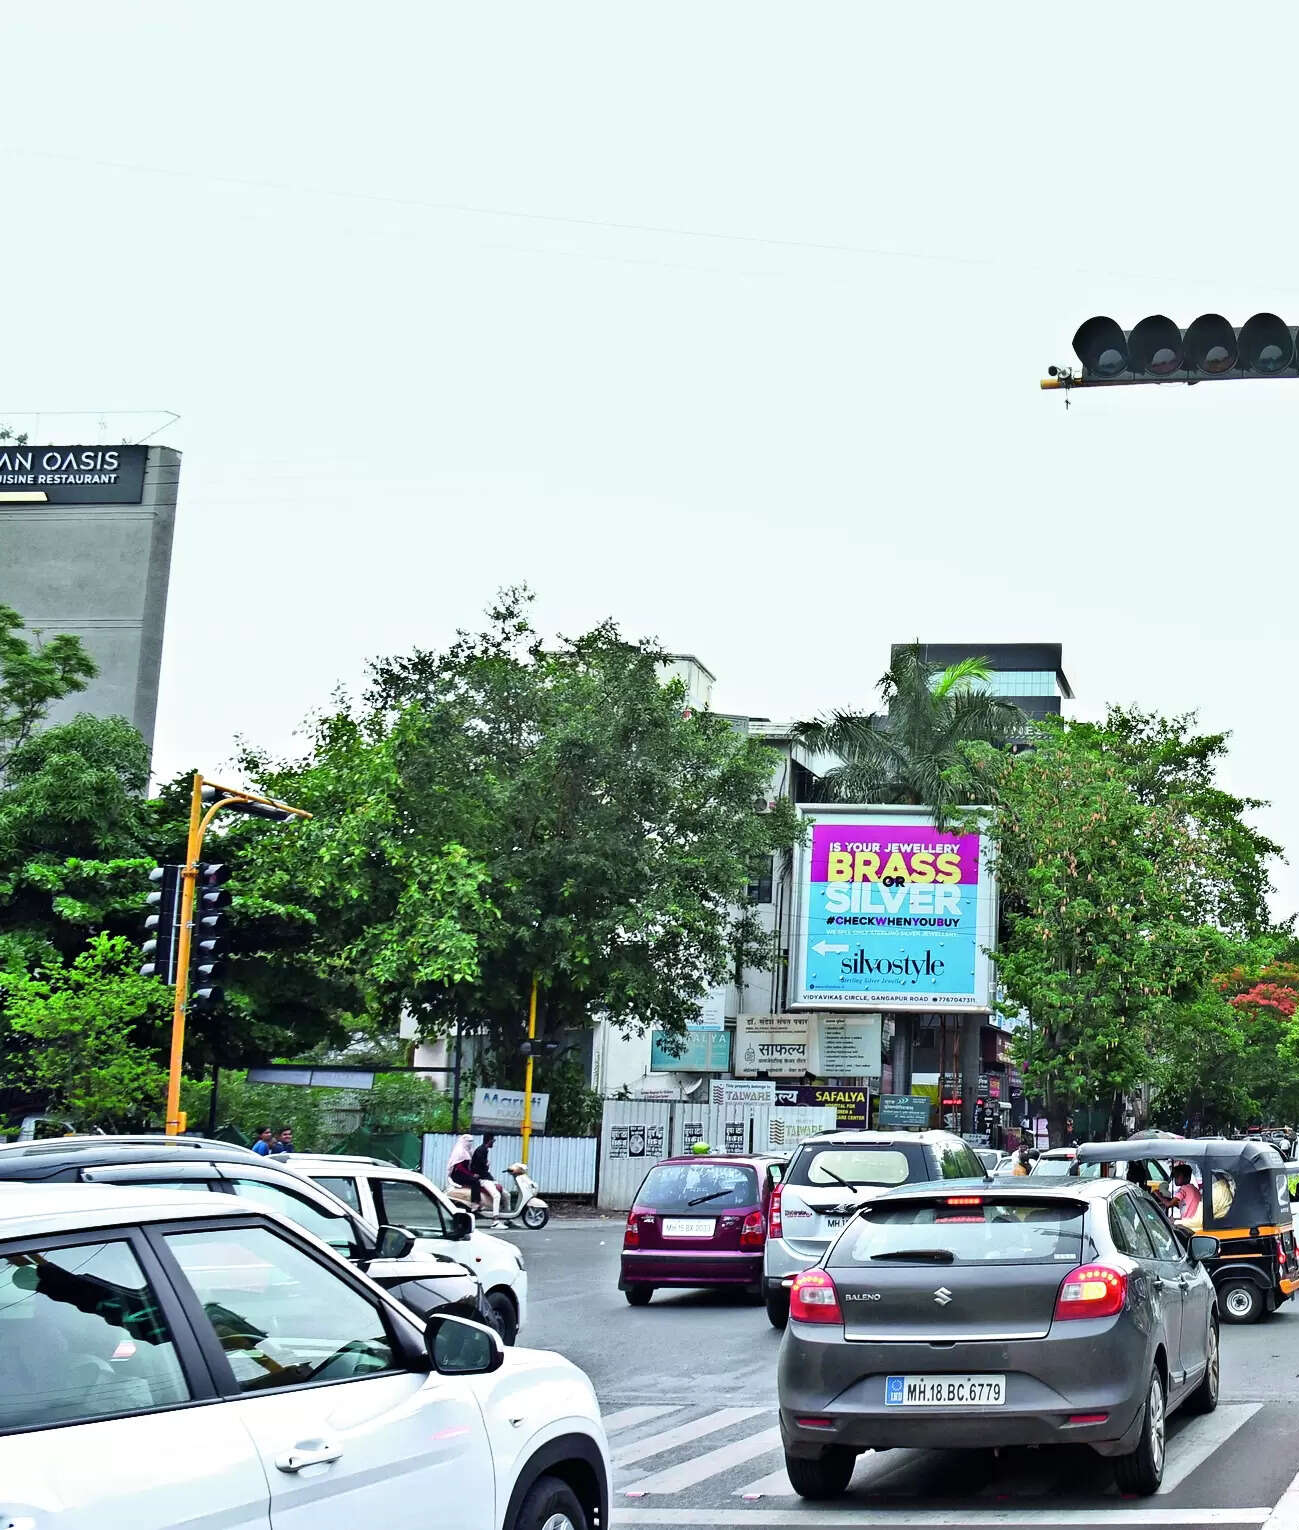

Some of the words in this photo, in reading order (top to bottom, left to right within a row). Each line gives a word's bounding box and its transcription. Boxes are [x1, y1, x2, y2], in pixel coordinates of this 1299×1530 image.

[42, 451, 119, 471] OASIS
[38, 473, 117, 484] RESTAURANT
[829, 842, 841, 852] IS
[846, 842, 880, 853] YOUR
[884, 843, 960, 854] JEWELLERY
[828, 852, 962, 884] BRASS
[882, 875, 905, 888] OR
[825, 883, 962, 915] SILVER
[826, 916, 960, 927] #CHECKWHENYOUBUY
[841, 948, 945, 984] silvostyle
[758, 1043, 807, 1057] साफल्य
[725, 1091, 771, 1101] TALWARE
[815, 1091, 865, 1102] SAFALYA
[845, 1293, 881, 1301] BALENO
[907, 1383, 1001, 1402] MH.18.BC.6779
